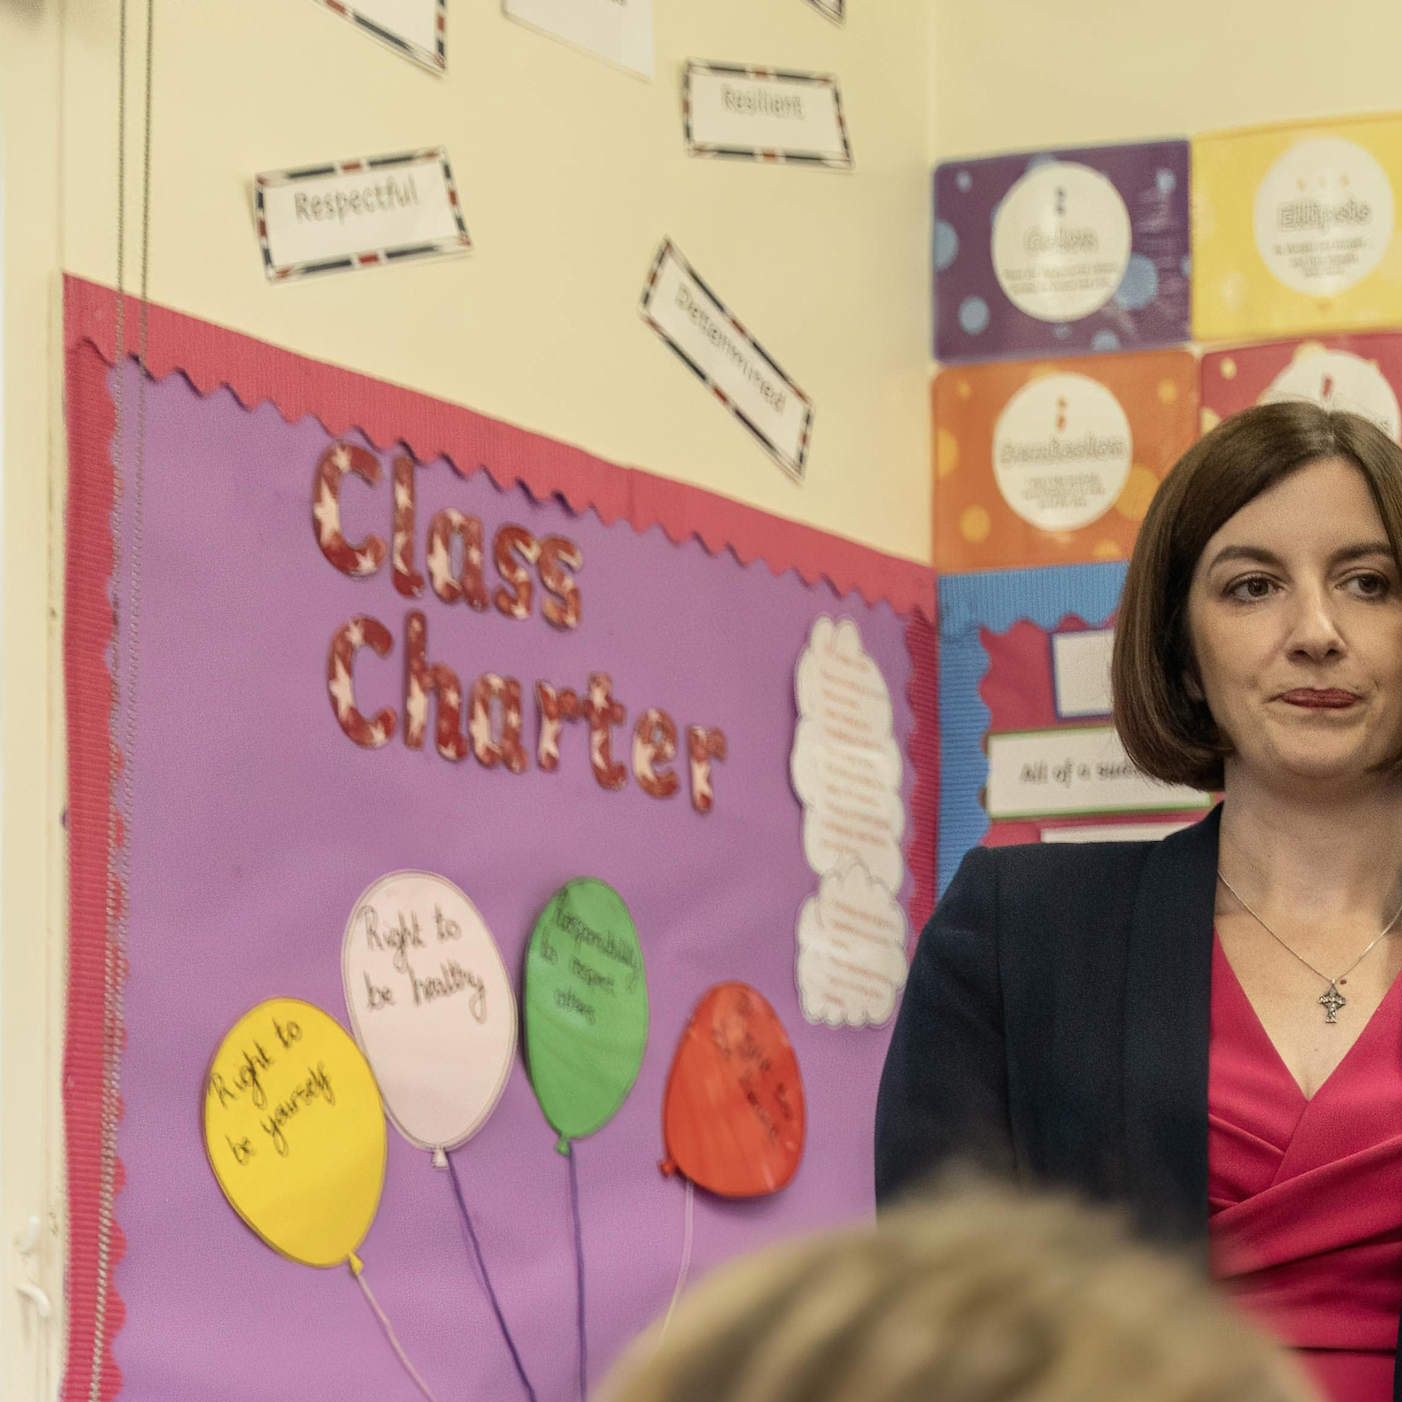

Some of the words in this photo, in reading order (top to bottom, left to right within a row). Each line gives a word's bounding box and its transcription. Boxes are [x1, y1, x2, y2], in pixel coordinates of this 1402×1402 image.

[293, 173, 419, 226] Respectful
[312, 438, 582, 631] Class
[326, 610, 726, 814] Charter
[1052, 758, 1073, 789] of
[357, 904, 425, 973] Right
[432, 903, 462, 941] to
[363, 971, 395, 1012] be
[406, 960, 489, 1025] healthy
[208, 1040, 273, 1111] Right
[273, 1015, 303, 1051] to
[225, 1133, 255, 1167] be
[261, 1060, 336, 1158] yourself
